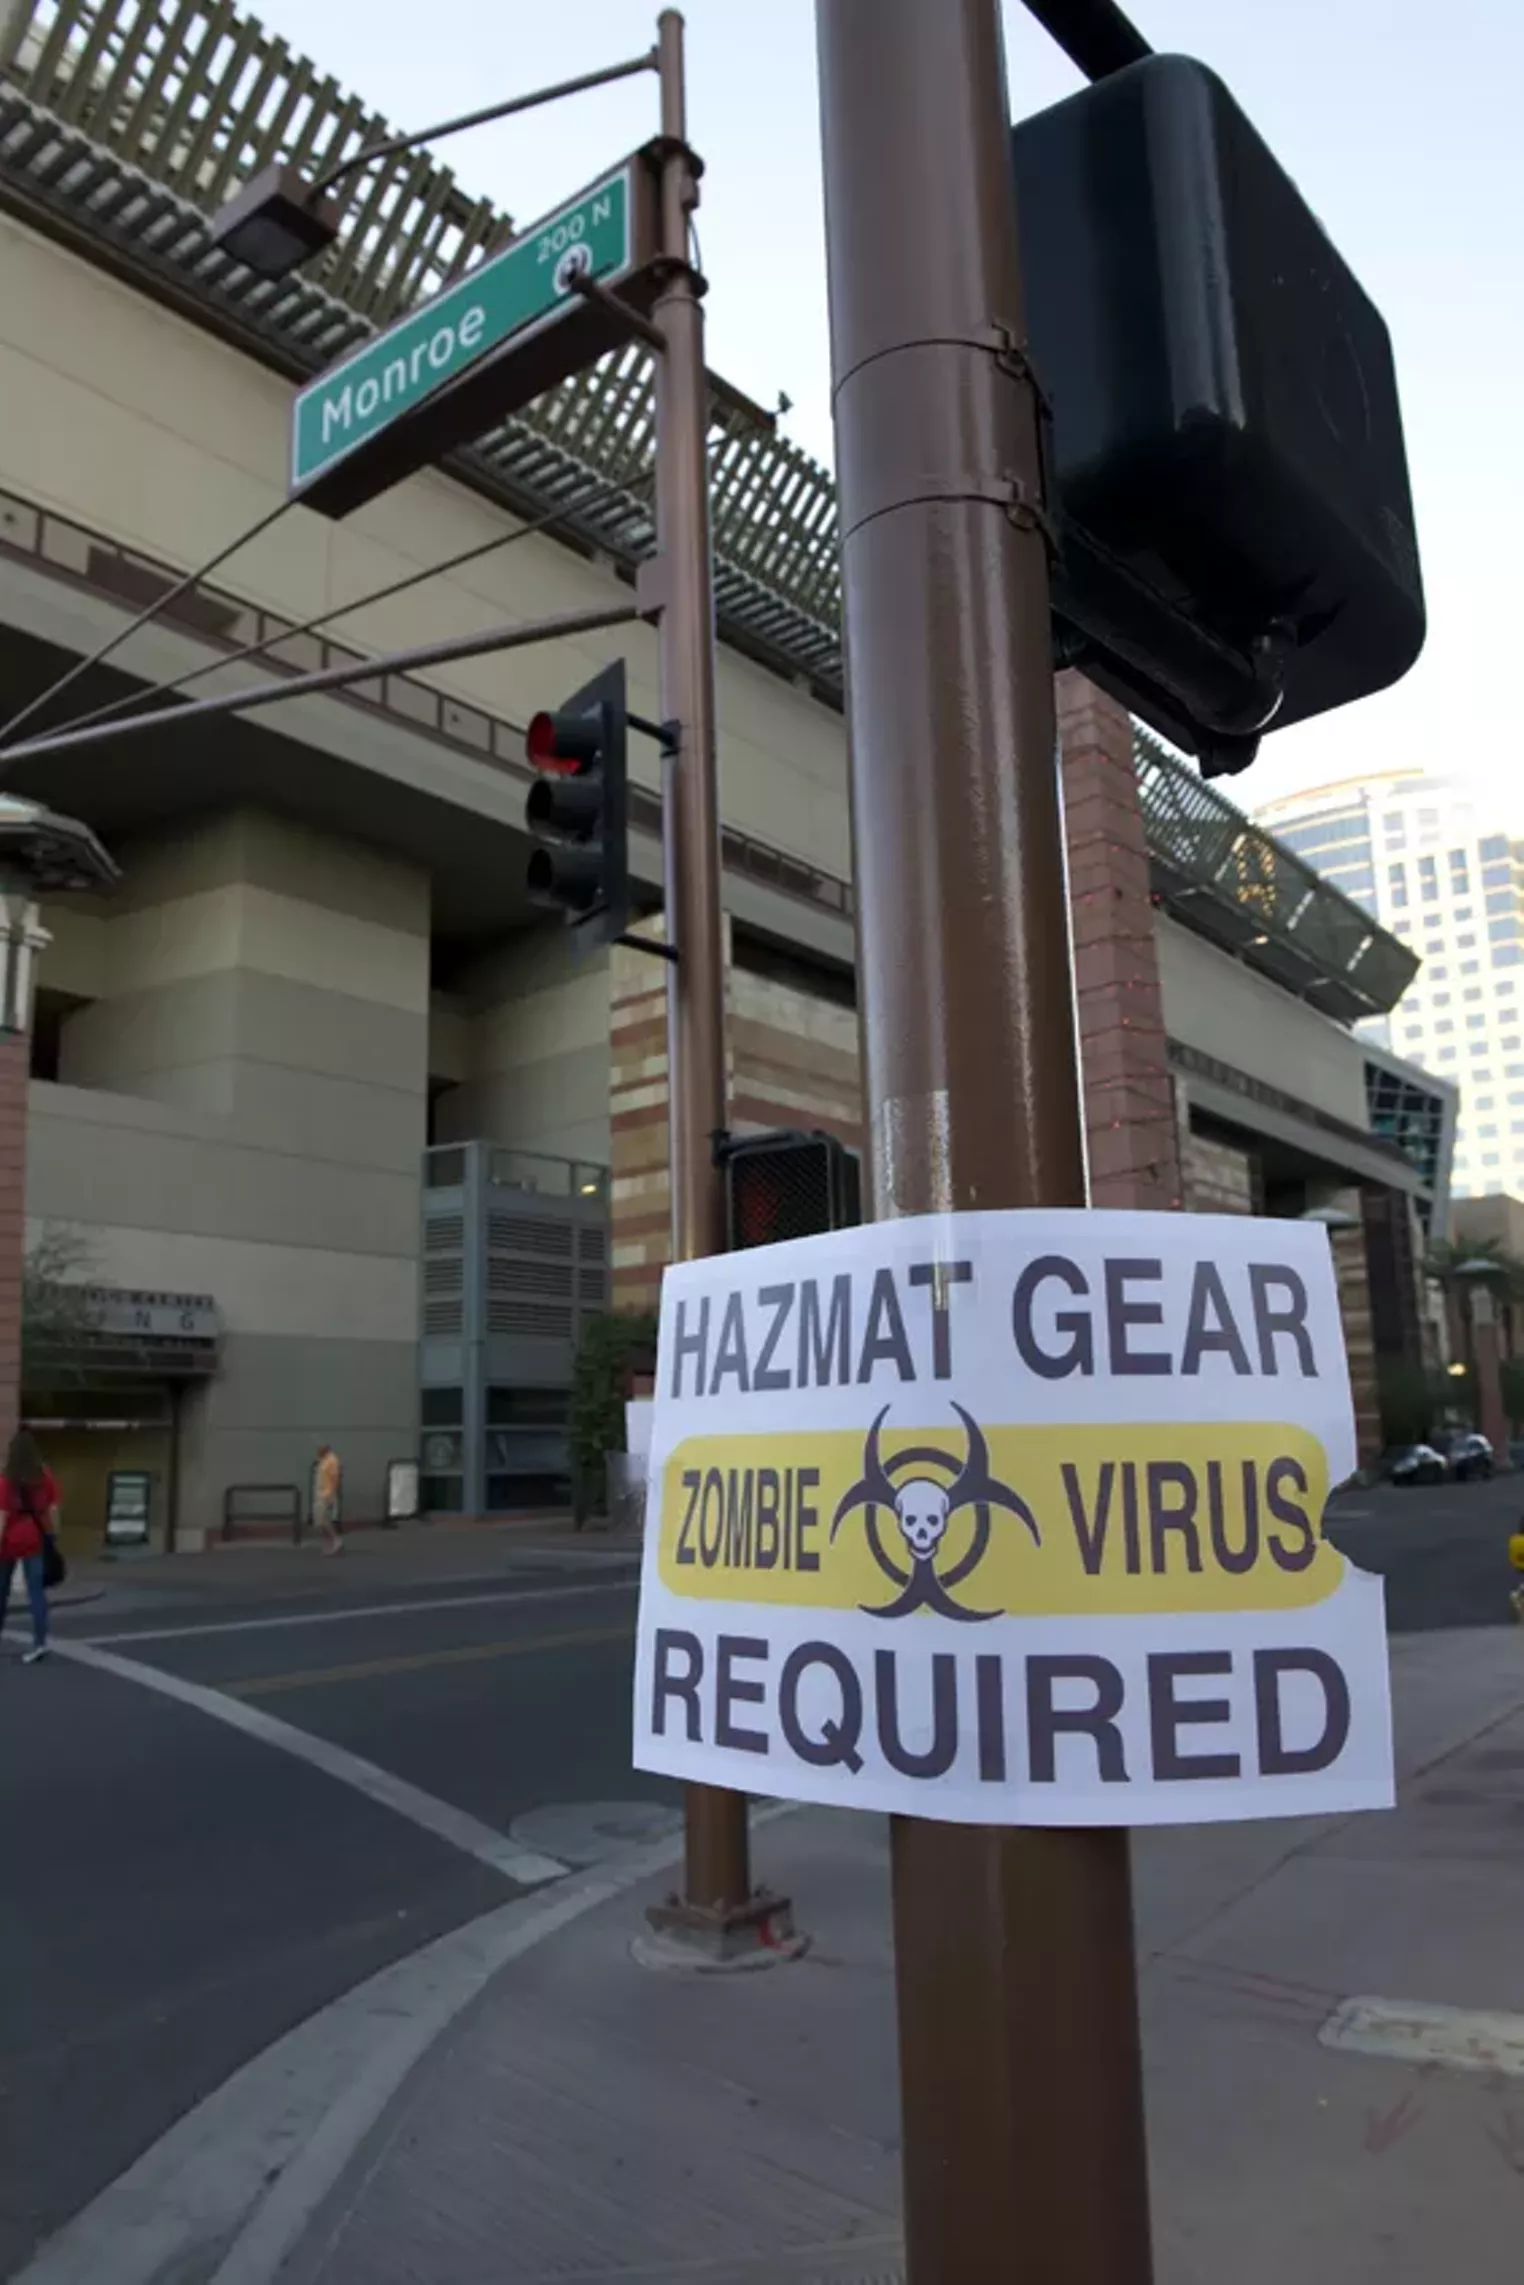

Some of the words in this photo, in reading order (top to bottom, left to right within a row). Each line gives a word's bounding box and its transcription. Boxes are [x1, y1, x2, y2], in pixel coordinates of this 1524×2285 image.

[537, 213, 586, 265] 200
[591, 194, 611, 227] N
[322, 305, 485, 443] Monroe
[670, 1260, 972, 1398] HAZMAT
[1011, 1254, 1319, 1380] GEAR
[675, 1466, 820, 1572] ZOMBIE
[1061, 1456, 1317, 1575] VIRUS
[650, 1628, 1351, 1784] REQUIRED
